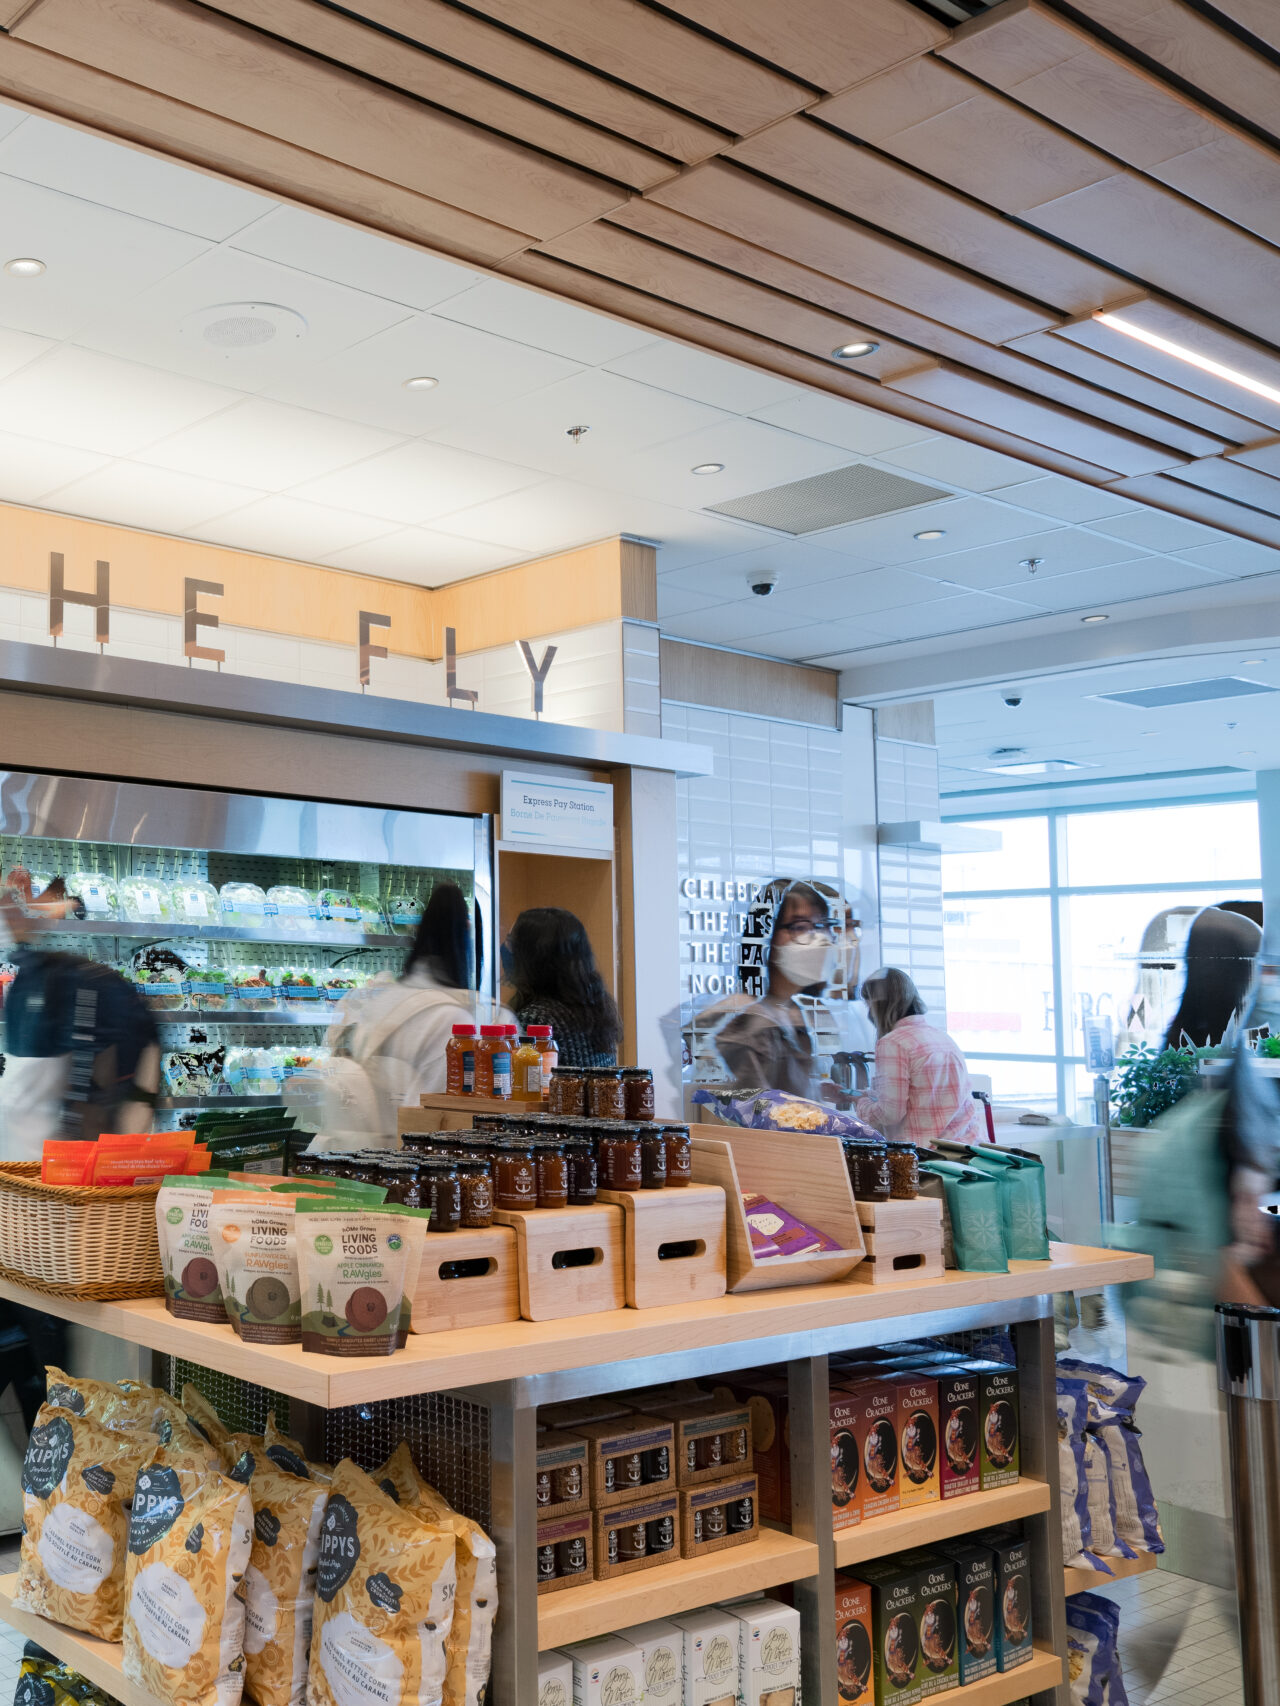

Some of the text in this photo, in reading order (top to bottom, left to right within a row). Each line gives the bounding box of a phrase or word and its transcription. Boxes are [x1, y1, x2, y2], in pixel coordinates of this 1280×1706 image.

[359, 610, 558, 713] FLY
[523, 795, 595, 813] Express Pay Station
[510, 808, 533, 820] Borne
[689, 911, 729, 932] THE
[691, 942, 730, 963] THE
[251, 1227, 288, 1236] LIVING
[342, 1234, 376, 1244] LIVING
[250, 1236, 287, 1245] FOODS
[342, 1244, 378, 1254] FOODS
[246, 1259, 289, 1270] RAWgles
[343, 1269, 382, 1280] RAWgles
[947, 1390, 975, 1403] CRACKERS
[986, 1385, 1014, 1397] CRACKERS
[902, 1396, 933, 1409] CRACKERS
[865, 1404, 894, 1418] CRACKERS
[131, 1493, 178, 1515] PPYS
[320, 1533, 355, 1558] IPPYS
[65, 1543, 85, 1557] KETTLE
[86, 1553, 102, 1564] CORN
[70, 1554, 78, 1562] AU
[78, 1558, 103, 1573] CARAMEL
[1004, 1558, 1028, 1573] CRACKERS
[966, 1570, 992, 1585] CRACKERS
[921, 1582, 951, 1596] CRACKERS
[886, 1595, 915, 1610] CRACKERS
[157, 1606, 174, 1624] KETTLE
[174, 1621, 190, 1635] CORN
[248, 1609, 264, 1623] CORN
[835, 1605, 867, 1621] CRACKERS
[161, 1620, 168, 1628] AU
[167, 1625, 191, 1647] CARAMEL
[346, 1658, 368, 1679] KETTLE
[368, 1676, 387, 1690] CORN
[352, 1674, 360, 1683] AU
[360, 1681, 389, 1702] CARAMEL
